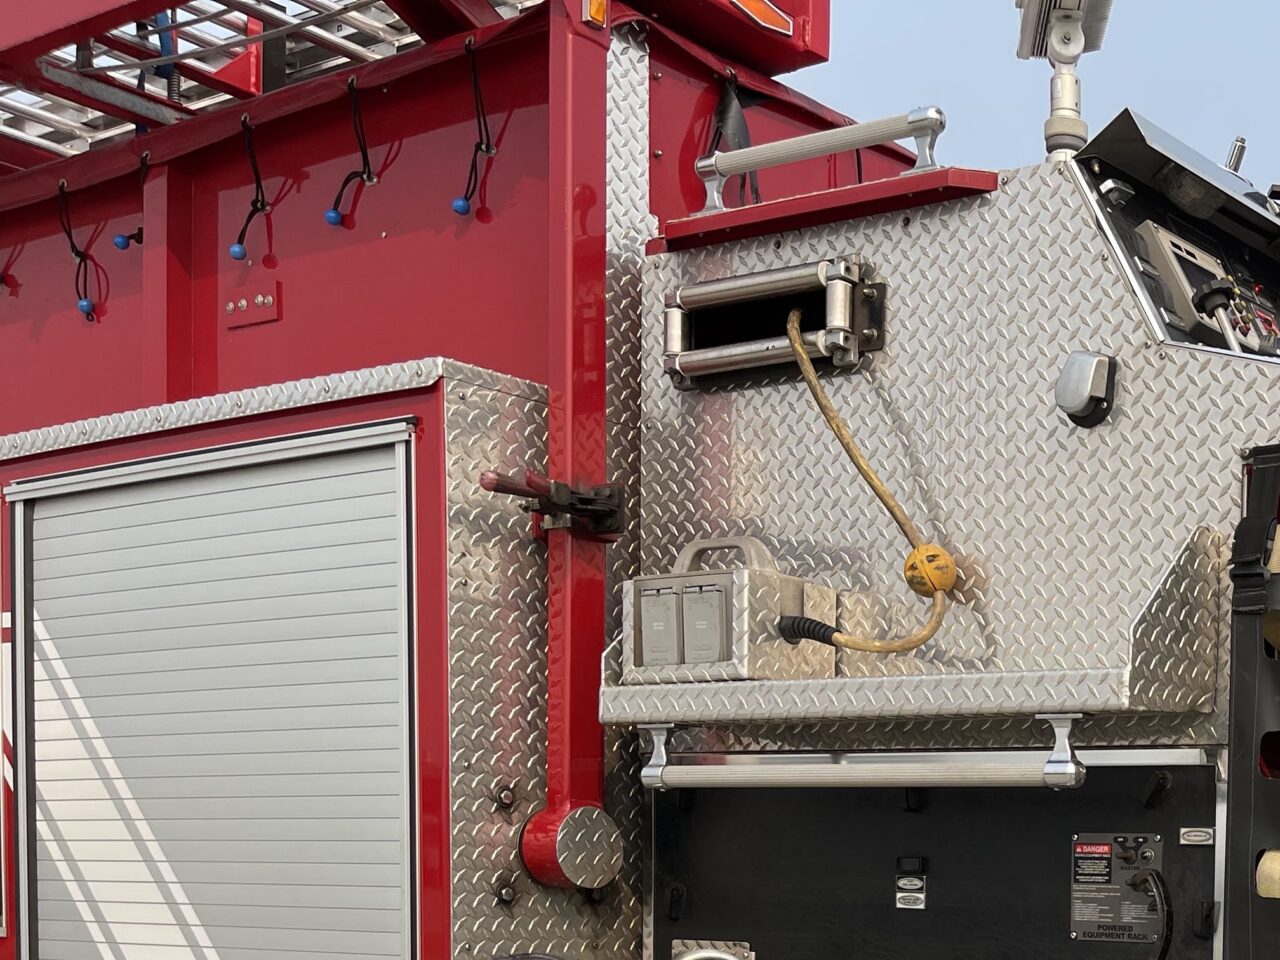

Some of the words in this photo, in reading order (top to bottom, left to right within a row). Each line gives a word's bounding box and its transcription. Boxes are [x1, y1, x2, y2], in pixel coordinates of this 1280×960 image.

[1082, 845, 1109, 853] DANGER
[1082, 931, 1126, 940] EQUIPMENT
[1127, 932, 1148, 940] RACK
